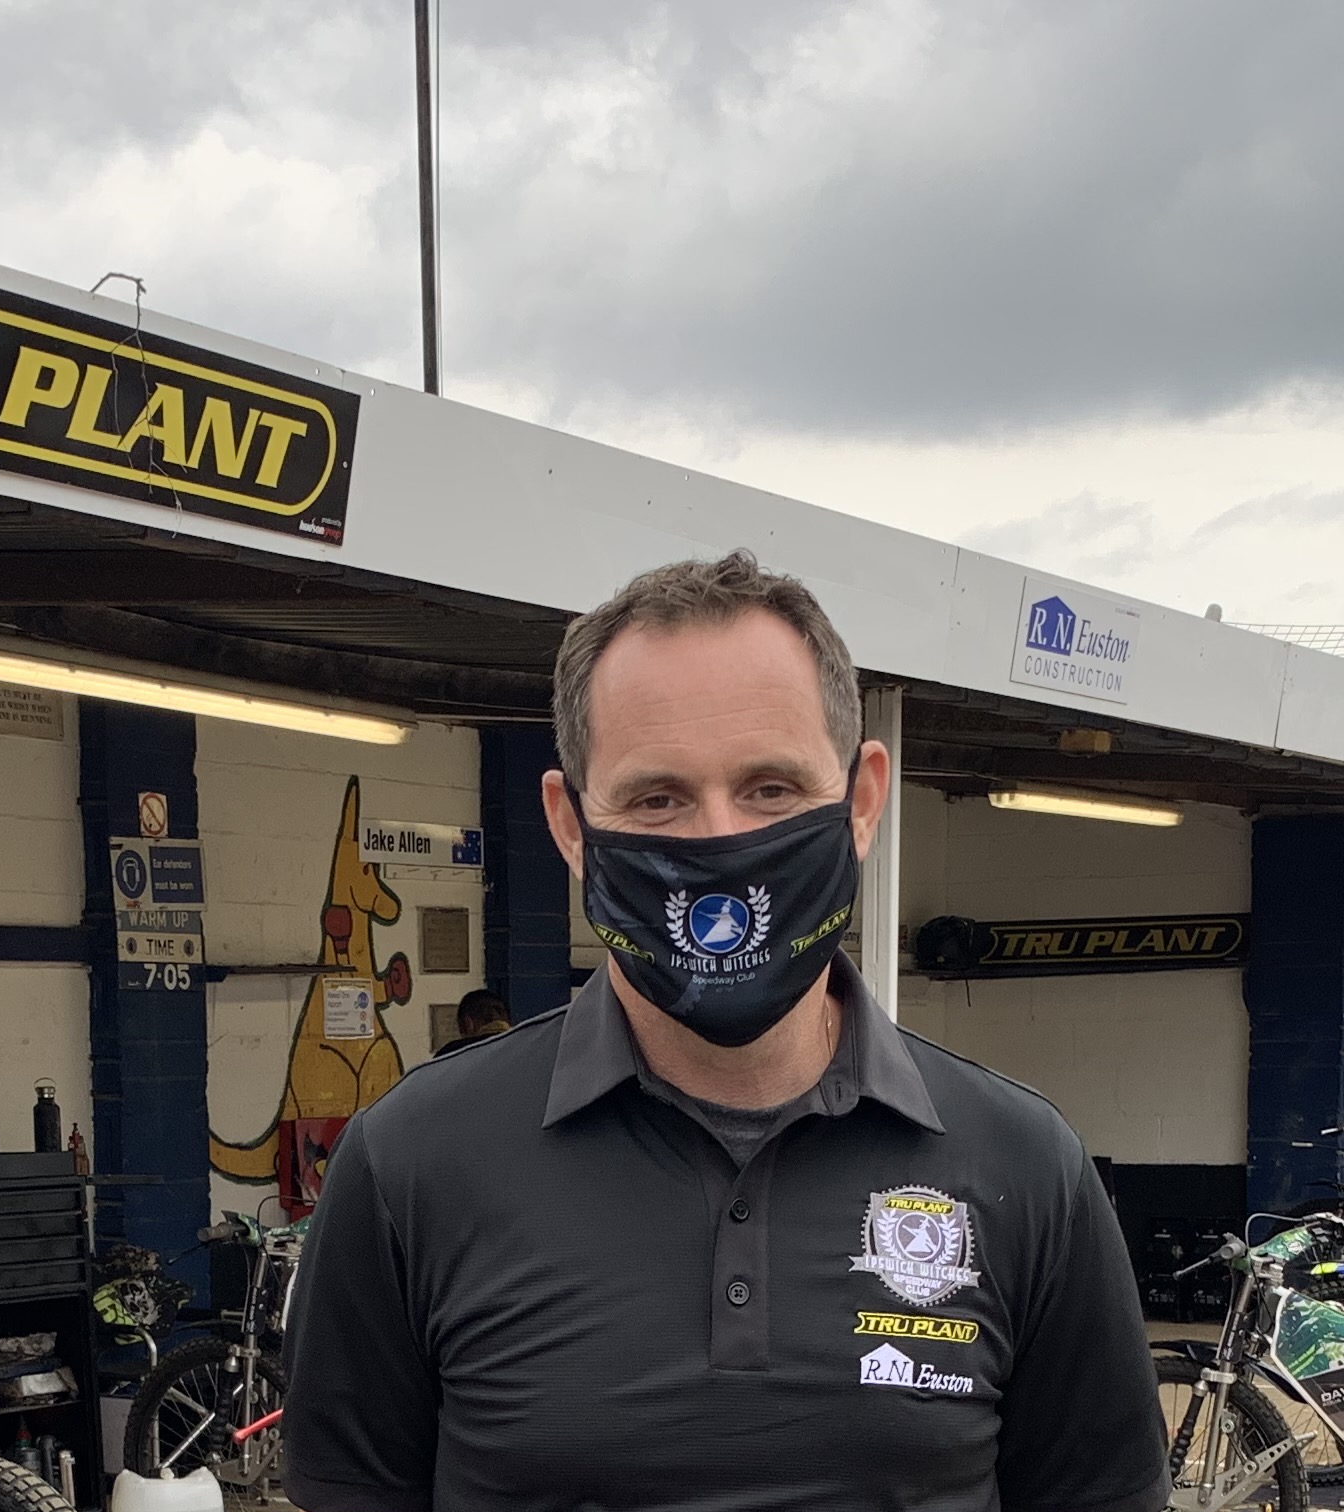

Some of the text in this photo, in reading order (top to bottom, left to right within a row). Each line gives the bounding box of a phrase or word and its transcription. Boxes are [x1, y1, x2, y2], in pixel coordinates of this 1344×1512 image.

[1075, 619, 1130, 663] Euston
[1024, 655, 1123, 692] CONSTRUCTION
[364, 828, 431, 854] Jake Allen
[128, 911, 189, 928] WARM UP
[146, 938, 175, 956] TIME
[1002, 926, 1226, 958] TRU PLANT
[670, 950, 771, 973] IPSWICH WITCHES
[692, 972, 756, 985] Speedway Club
[890, 1199, 951, 1214] TRU PLANT
[865, 1256, 971, 1282] IPSWICH WITCHES
[905, 1285, 931, 1296] CLUB
[866, 1317, 975, 1340] TRU PLANT
[914, 1363, 974, 1393] Euston
